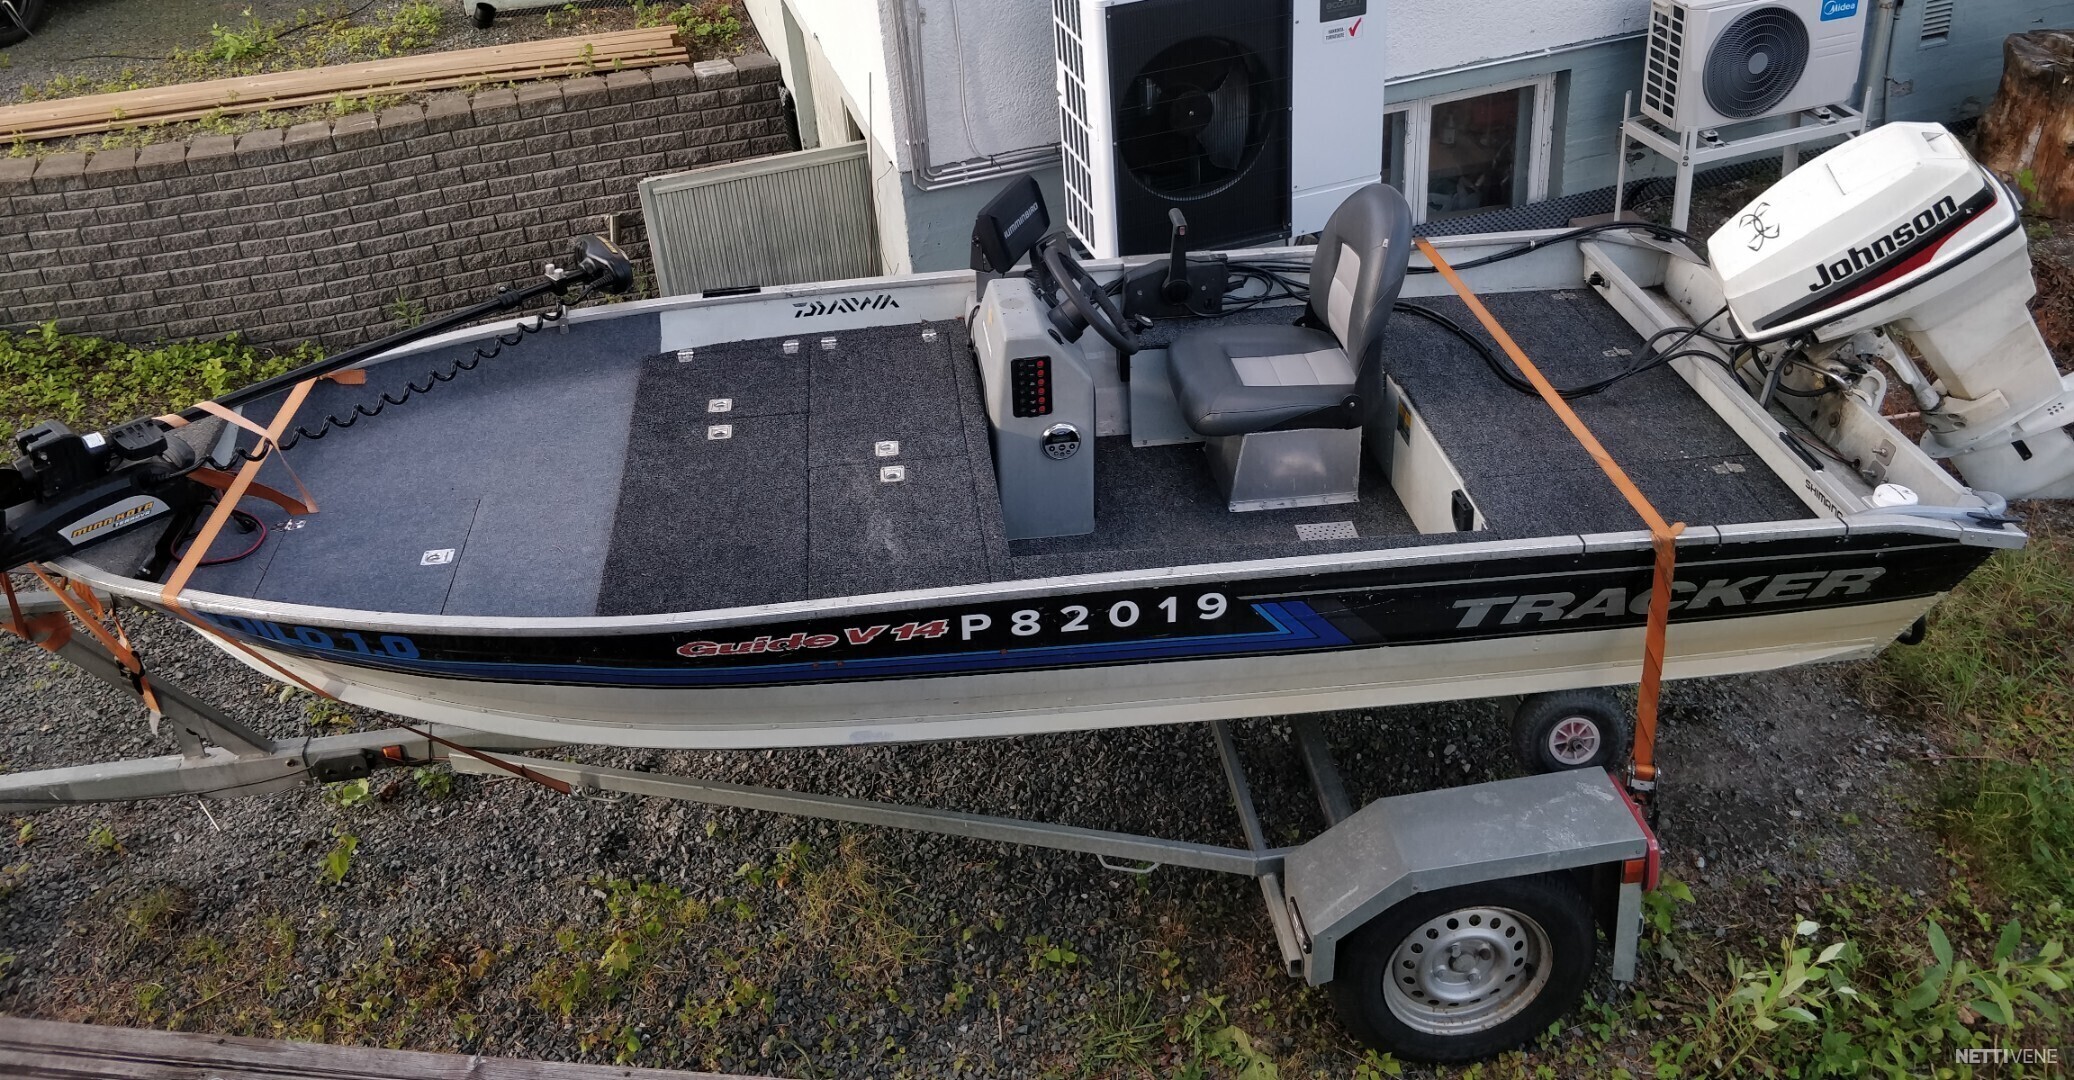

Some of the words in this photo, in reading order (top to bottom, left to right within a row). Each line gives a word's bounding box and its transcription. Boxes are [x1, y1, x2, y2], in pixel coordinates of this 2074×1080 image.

[1824, 0, 1856, 15] Midea
[1808, 195, 1958, 292] Johnson
[792, 295, 900, 318] DAIWA
[342, 631, 421, 659] 1.0
[676, 633, 839, 657] Guide
